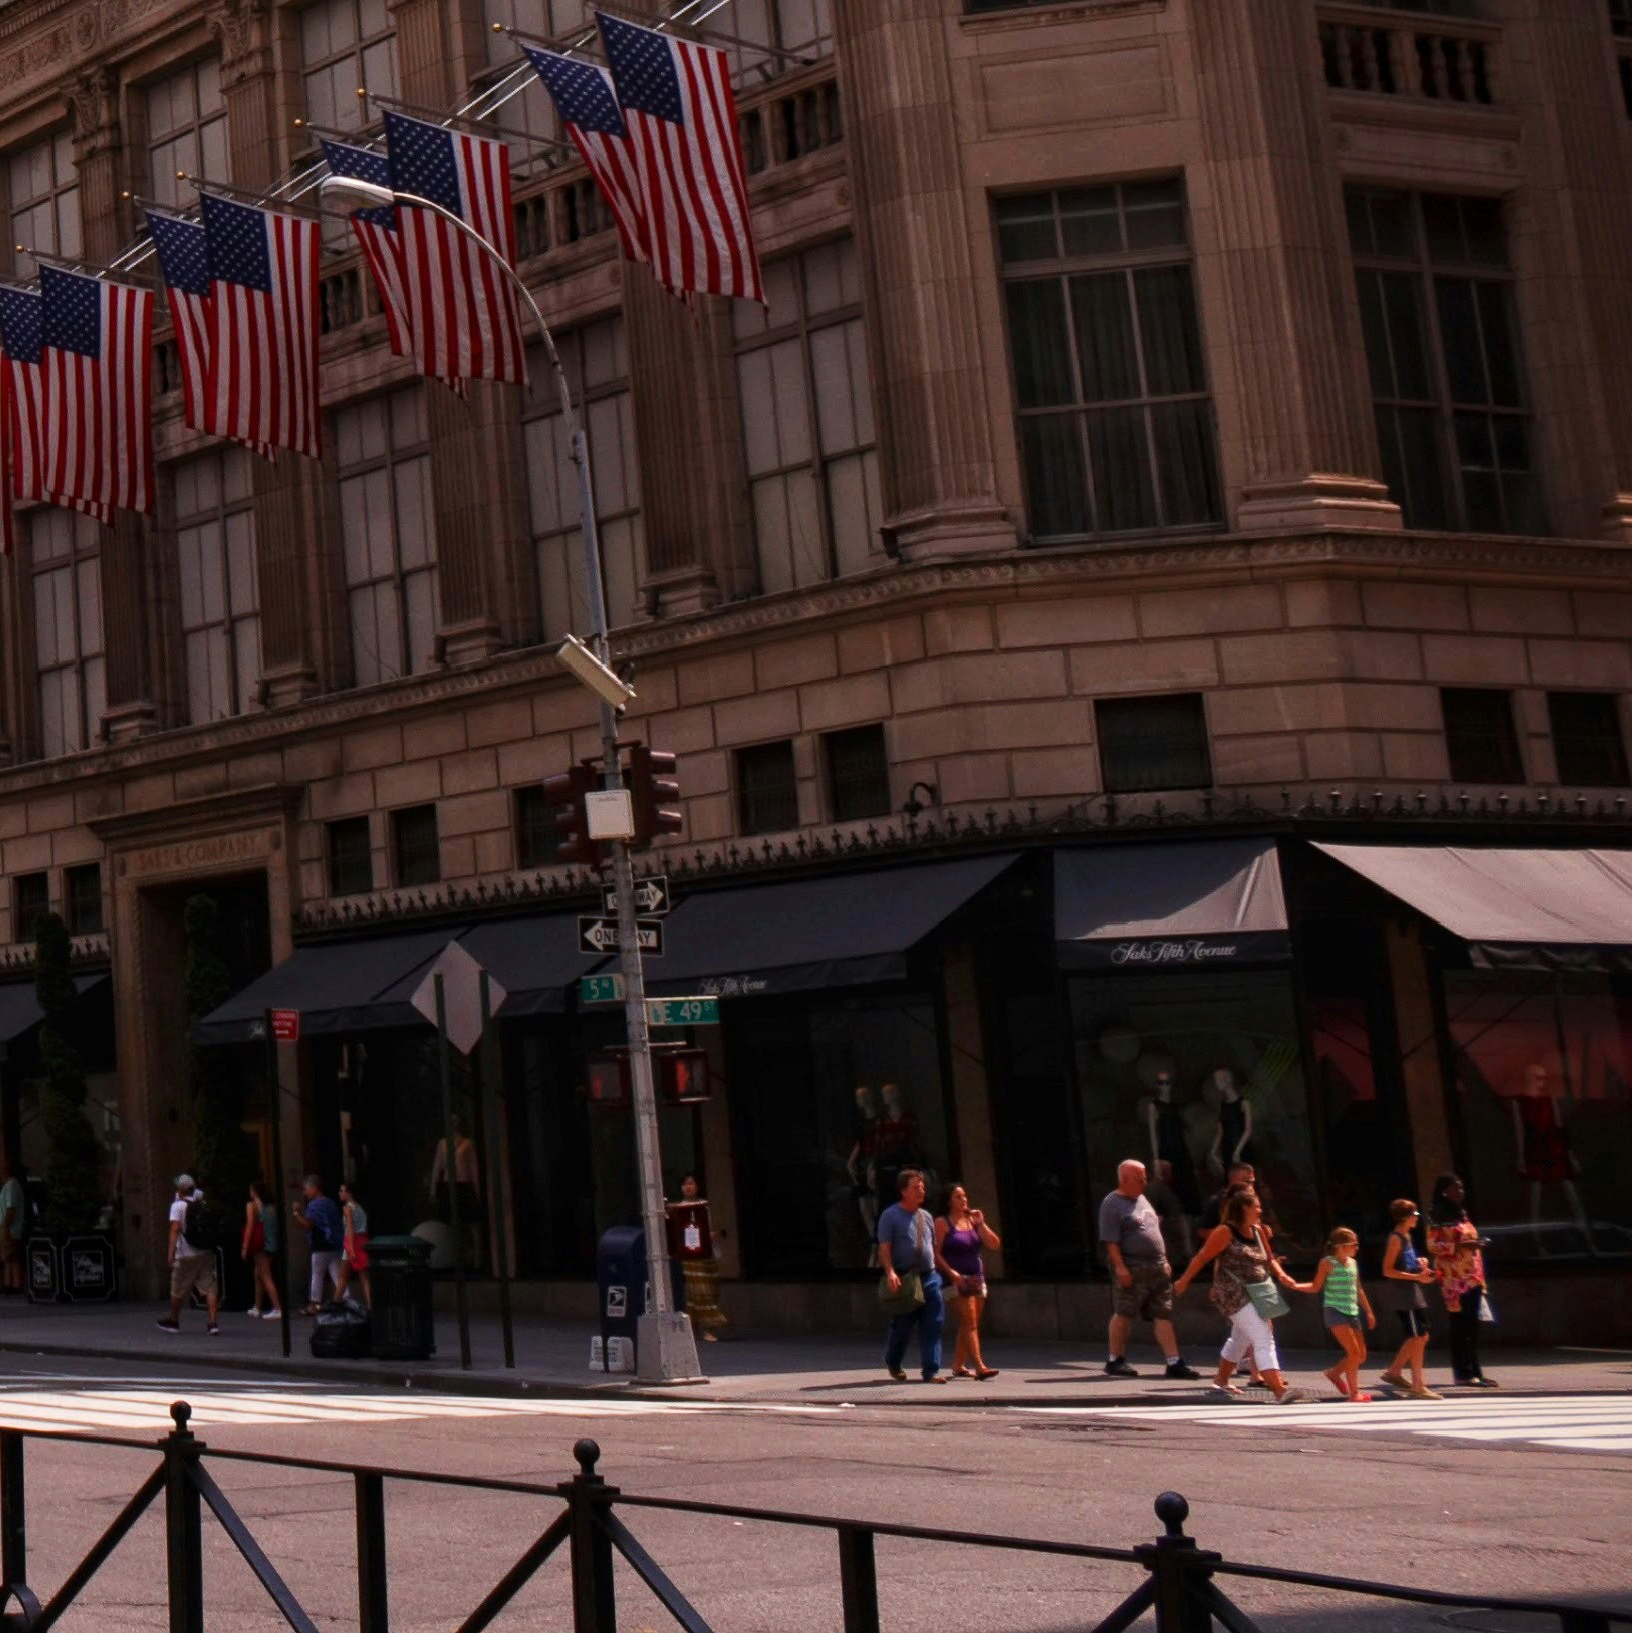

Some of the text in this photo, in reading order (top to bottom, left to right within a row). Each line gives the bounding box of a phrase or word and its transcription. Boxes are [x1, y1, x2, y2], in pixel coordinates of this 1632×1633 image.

[185, 834, 258, 865] COMPANY
[1110, 939, 1238, 965] Saks Fifth Avenue
[589, 979, 601, 1000] 5
[665, 1000, 716, 1022] E 49 ST
